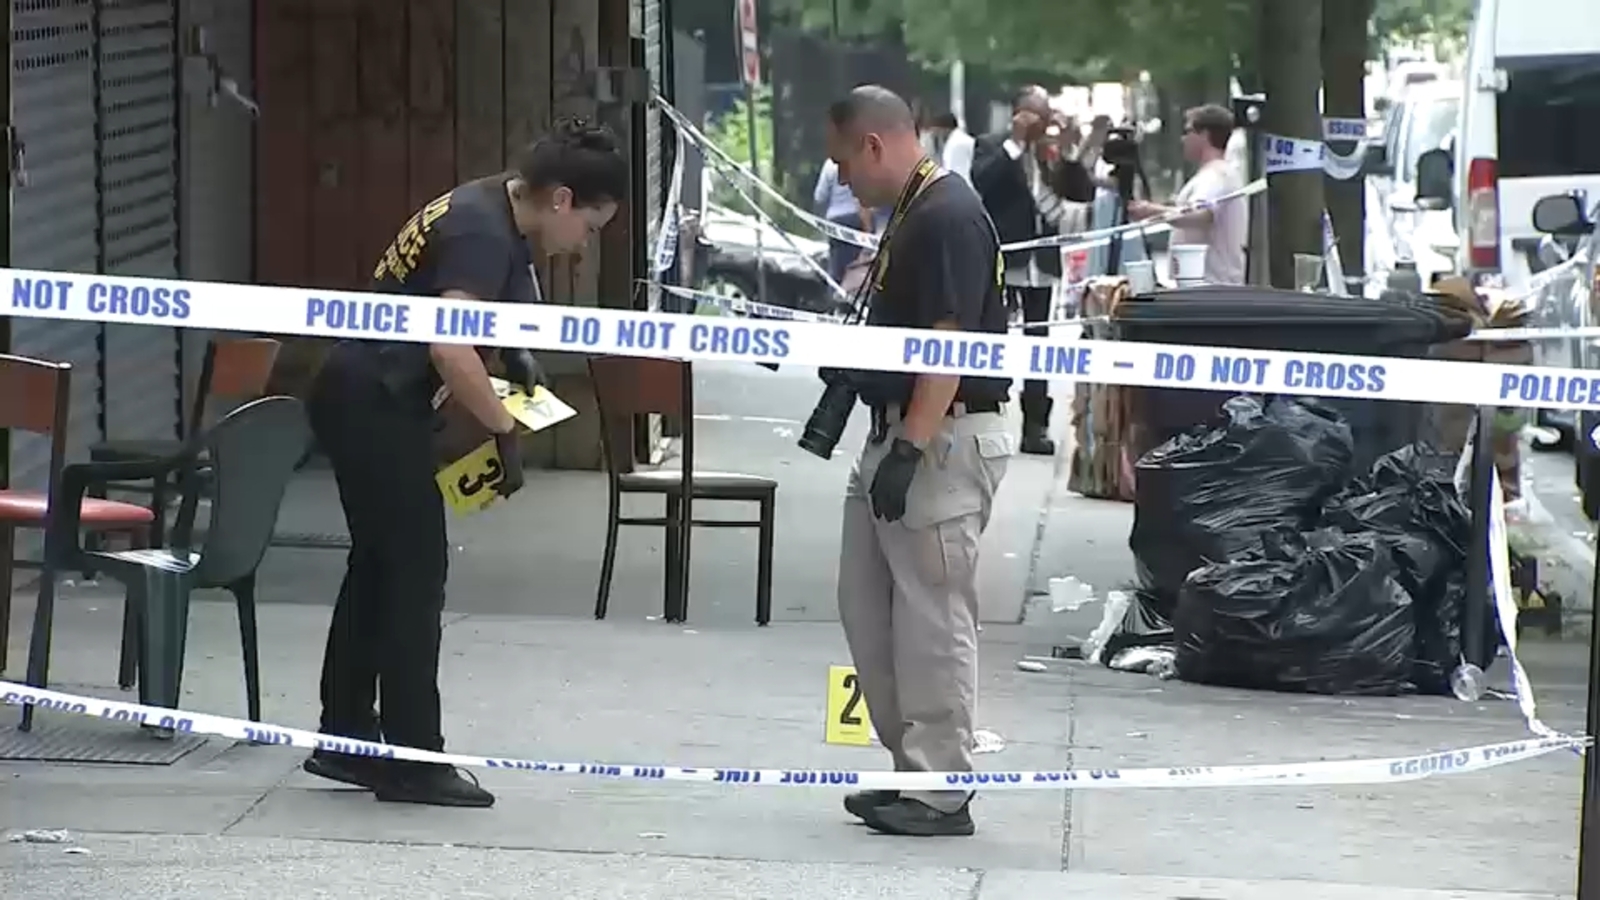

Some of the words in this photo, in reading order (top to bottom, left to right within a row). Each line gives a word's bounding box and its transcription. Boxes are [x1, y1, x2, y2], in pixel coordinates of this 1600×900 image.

[12, 279, 72, 311] NOT
[87, 283, 191, 319] CROSS
[306, 298, 409, 334] POLICE
[435, 310, 497, 338] LINE
[560, 317, 600, 346] DO
[616, 320, 674, 349] NOT
[690, 324, 791, 357] CROSS
[903, 337, 1004, 371] POLICE
[1030, 346, 1091, 374] LINE
[1154, 352, 1196, 381] DO
[1211, 357, 1270, 386] NOT
[1284, 359, 1387, 392] CROSS
[1500, 372, 1600, 404] POLICE
[457, 458, 502, 496] 3
[840, 673, 862, 726] 2
